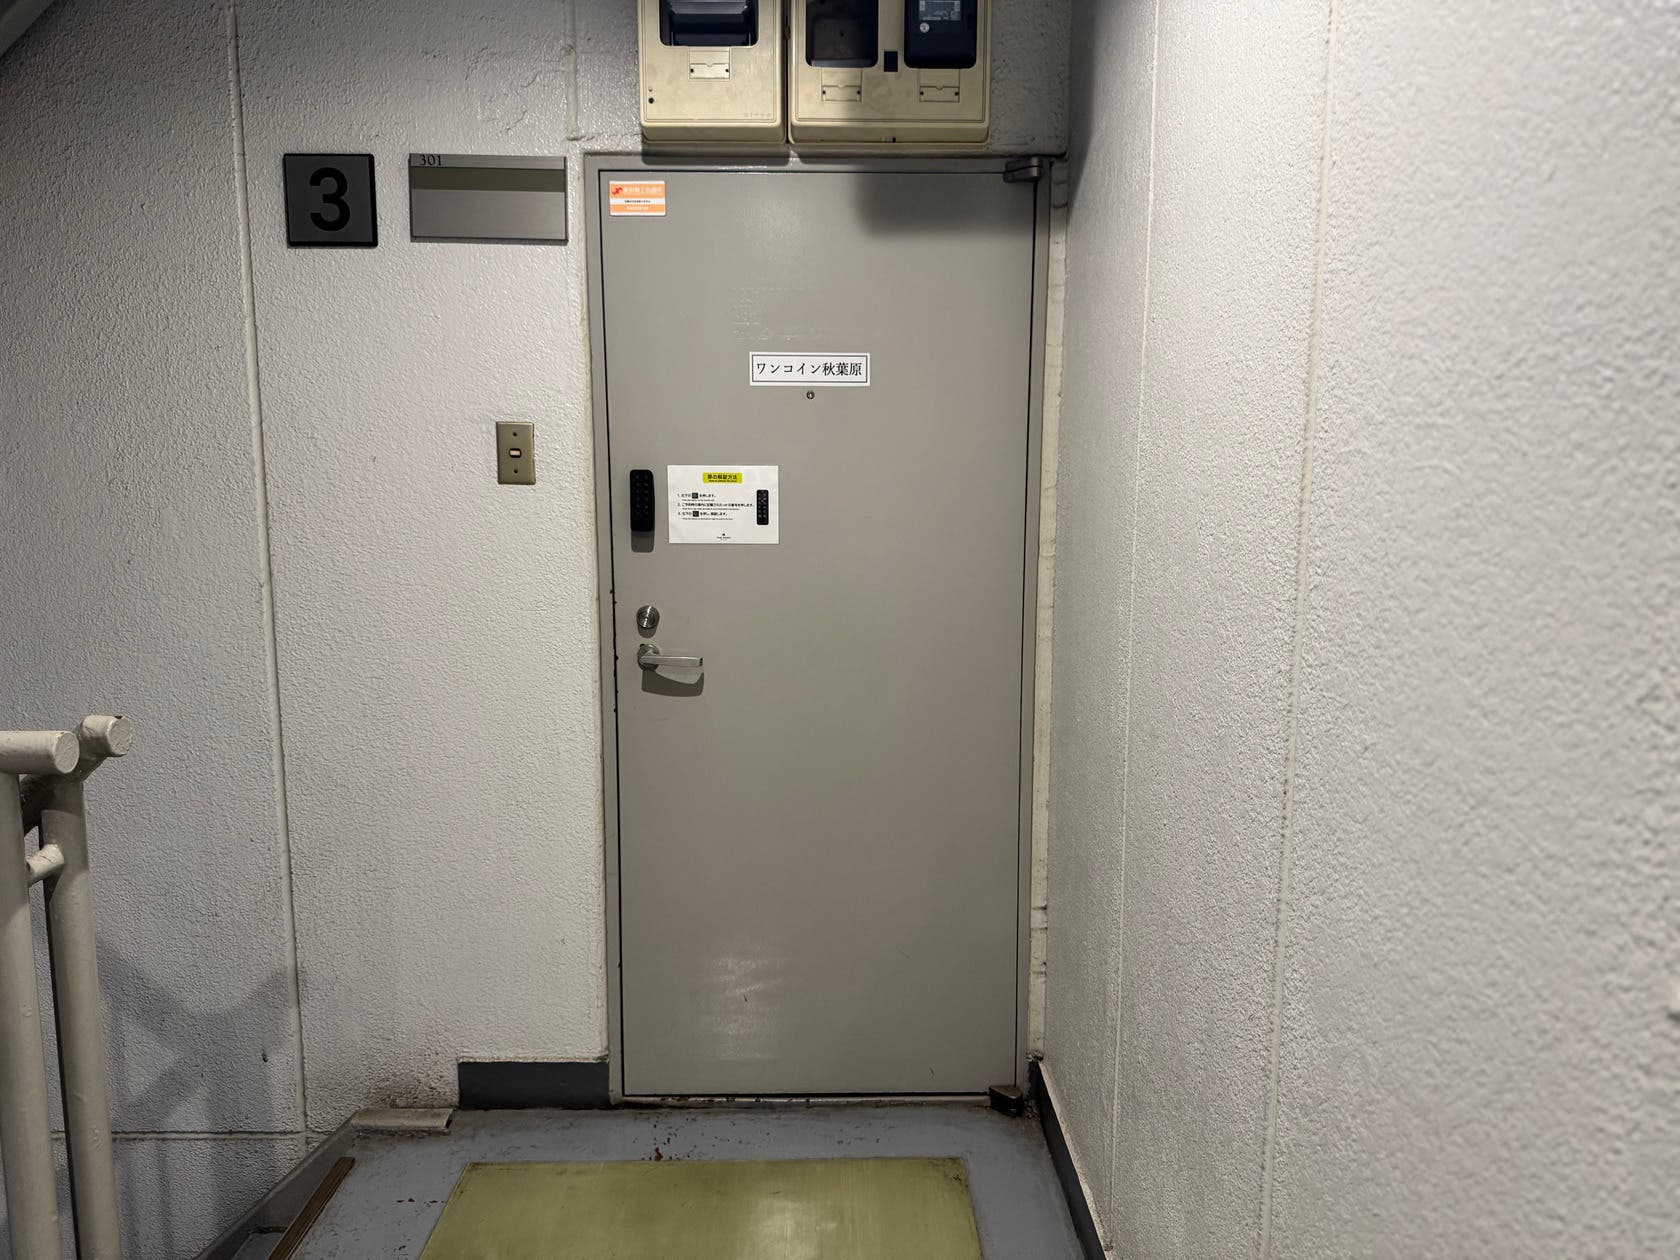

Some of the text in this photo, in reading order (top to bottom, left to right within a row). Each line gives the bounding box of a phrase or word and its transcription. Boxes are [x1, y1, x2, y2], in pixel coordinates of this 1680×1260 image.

[418, 154, 442, 166] 301
[309, 167, 351, 232] 3
[756, 362, 863, 376] ワンコイン秋葉原
